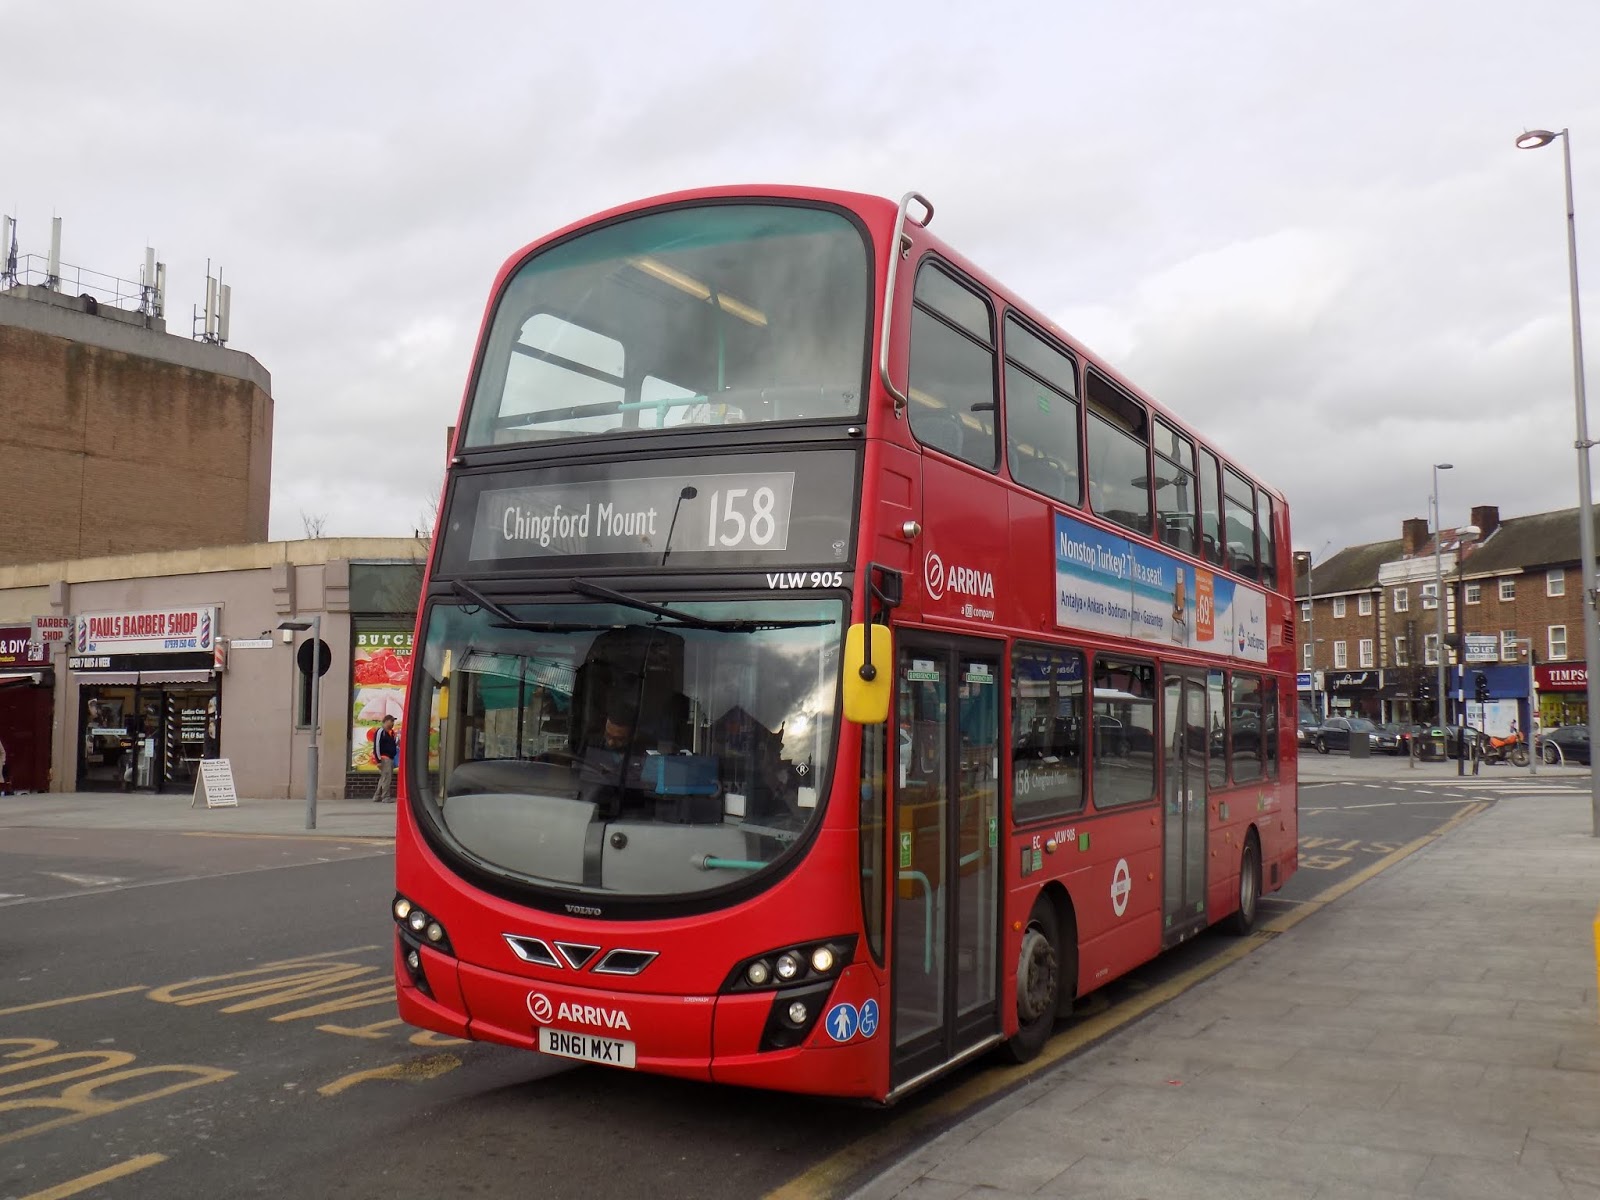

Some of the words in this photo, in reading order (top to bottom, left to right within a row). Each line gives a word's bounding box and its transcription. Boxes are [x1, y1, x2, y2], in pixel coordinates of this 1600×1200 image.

[503, 503, 590, 547] Chingford
[597, 502, 657, 537] Mount
[707, 486, 776, 548] 158
[1060, 531, 1096, 571] Nonstop
[1097, 544, 1126, 579] Turkey?
[1141, 565, 1145, 580] a
[1146, 566, 1163, 587] seat!
[766, 572, 806, 589] VLW
[810, 571, 843, 588] 905
[946, 565, 995, 599] ARRIVA
[961, 606, 965, 615] a
[973, 608, 995, 621] company
[1060, 590, 1083, 613] Antalya
[1086, 597, 1104, 615] Ankara
[1107, 601, 1128, 620] Bodrum
[37, 618, 69, 629] BARBER
[42, 630, 63, 641] SHOP
[89, 616, 121, 638] PAULS
[123, 614, 165, 637] BARBER
[168, 612, 198, 635] SHOP
[0, 640, 7, 654] &
[10, 639, 27, 654] DIY
[1015, 769, 1030, 795] 158
[1032, 835, 1041, 850] EC
[1054, 829, 1067, 844] VLW
[1066, 828, 1076, 842] 905
[564, 904, 602, 916] VOLVO
[557, 1002, 632, 1031] ARRIVA
[549, 1031, 586, 1056] BN61
[591, 1038, 624, 1062] MXT
